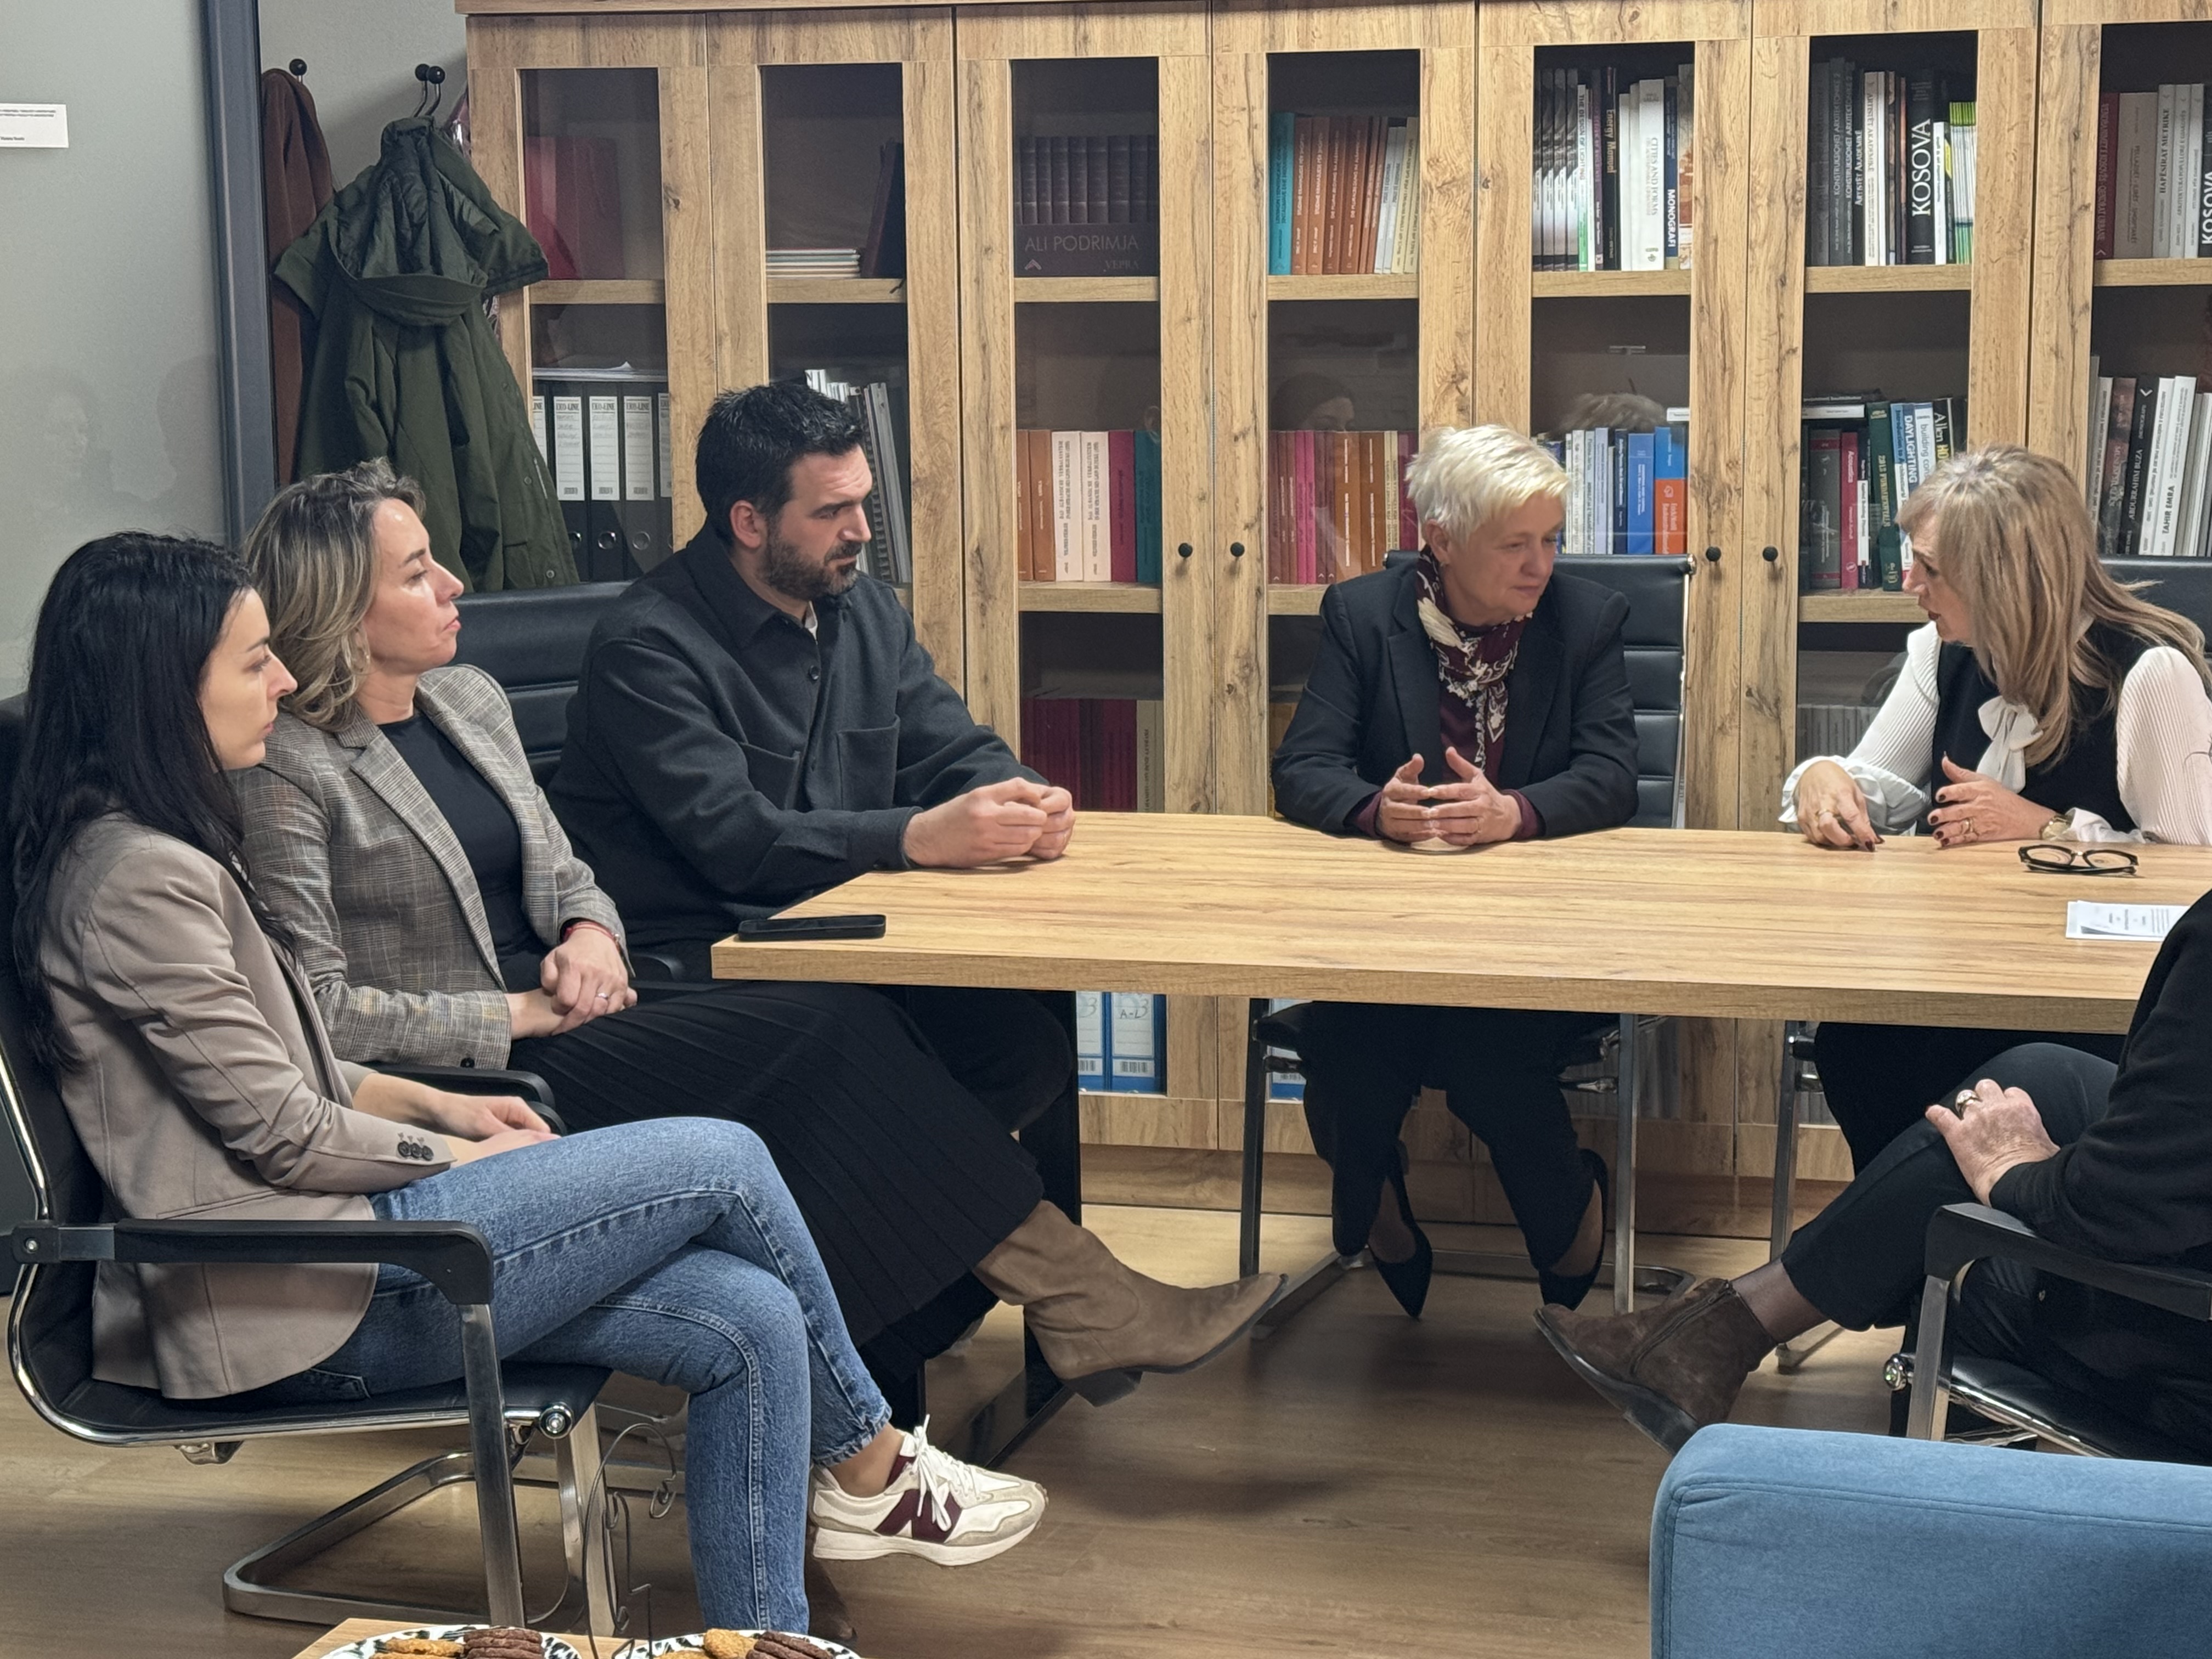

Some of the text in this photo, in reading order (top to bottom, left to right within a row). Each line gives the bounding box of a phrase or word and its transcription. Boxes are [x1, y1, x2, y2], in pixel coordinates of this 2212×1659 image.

[1866, 93, 1874, 126] ARTISTËT
[1604, 109, 1616, 173] Energy Manual
[1911, 119, 1932, 217] KOSOVA
[1666, 189, 1677, 247] MONOGRAFI
[1025, 234, 1138, 252] ALI PODRIMJA
[1894, 410, 1903, 449] Introduction
[1918, 424, 1931, 457] building
[1934, 411, 1948, 442] Allen
[1847, 450, 1855, 483] Acoustics
[1904, 415, 1917, 483] DAYLIGHTING
[2134, 448, 2143, 469] BUZA
[2128, 470, 2141, 520] ABDURRAHIM
[2161, 484, 2176, 534] TAHIR EMRA
